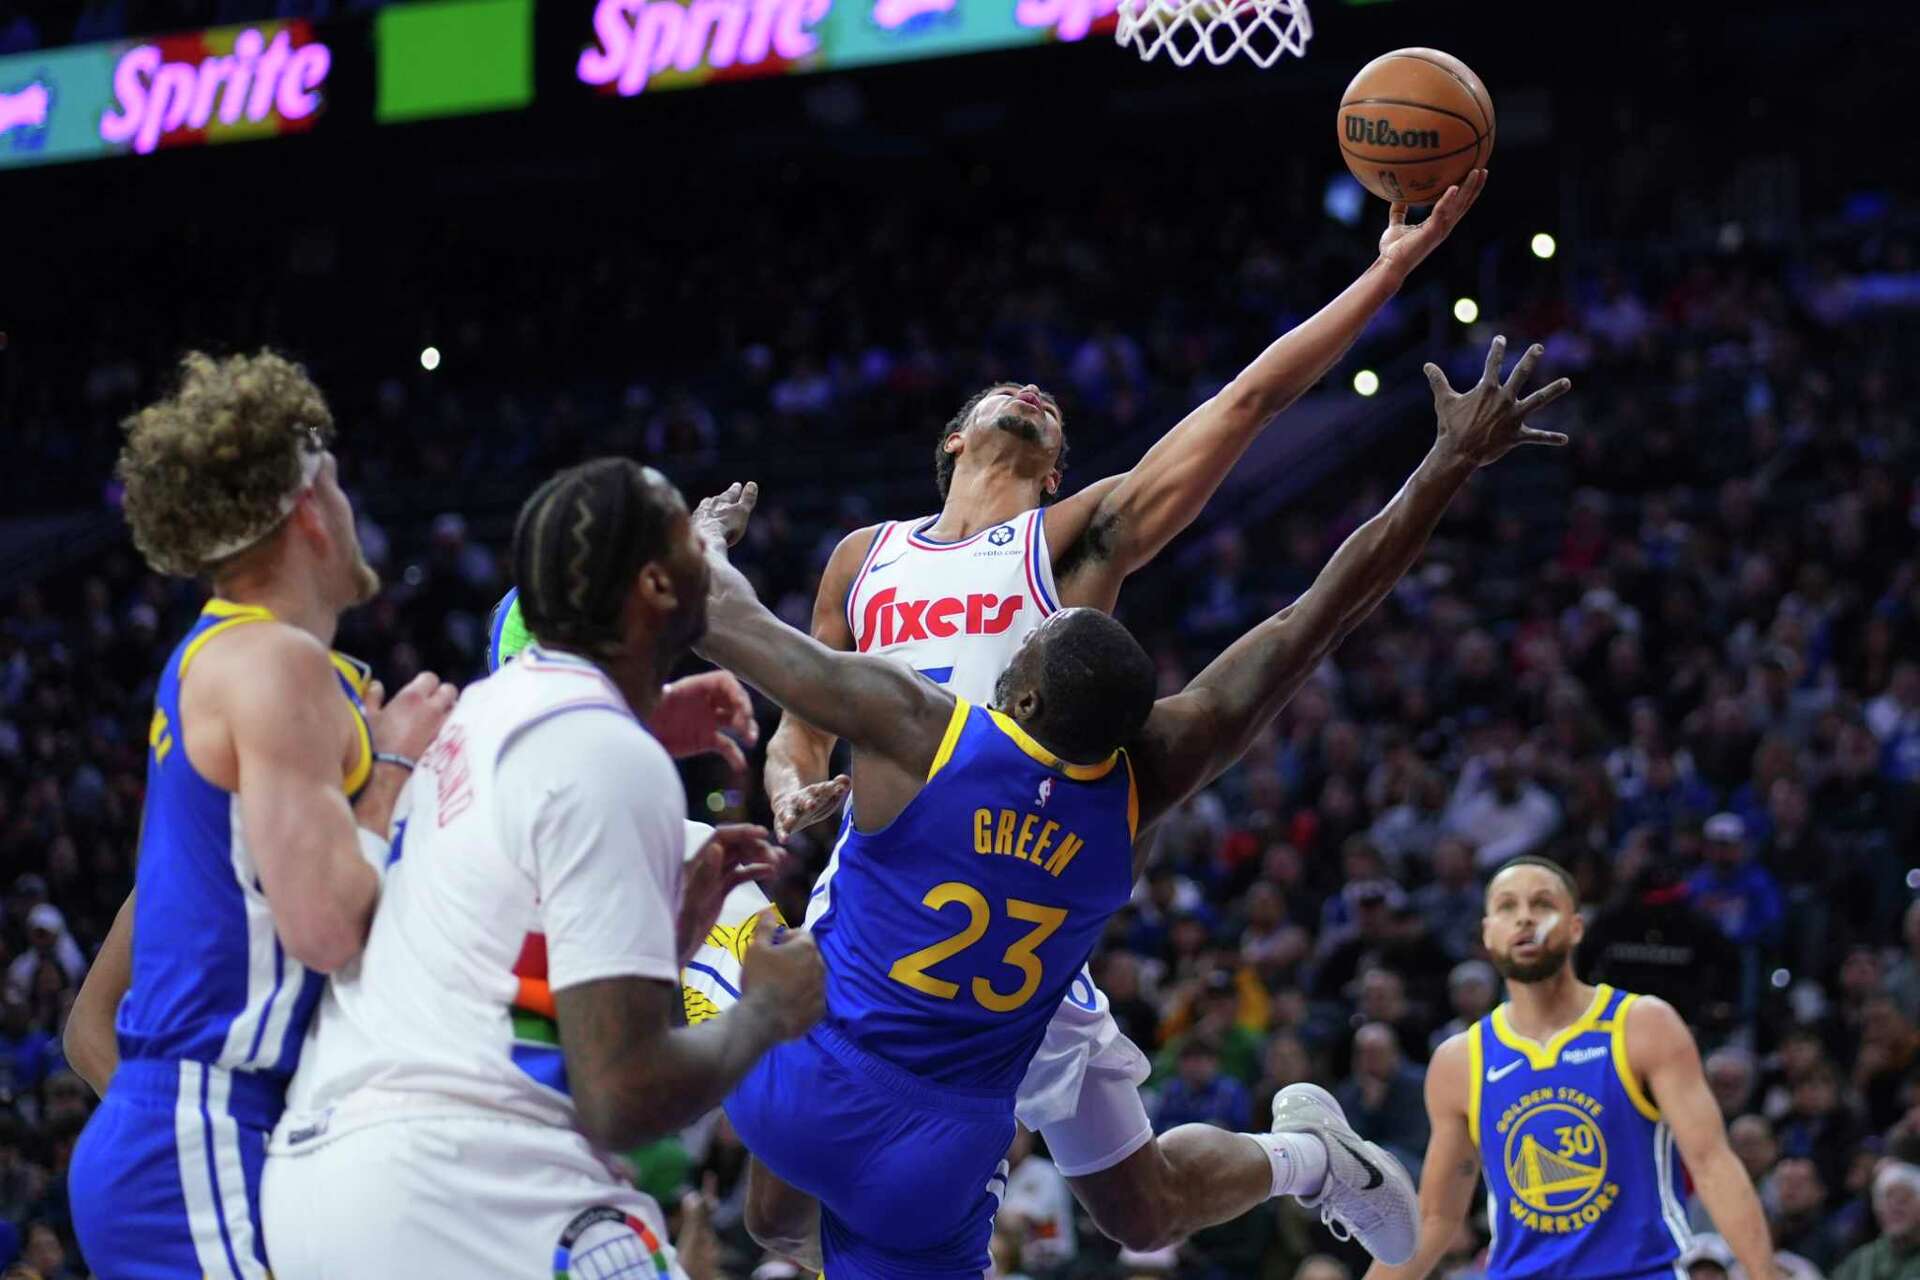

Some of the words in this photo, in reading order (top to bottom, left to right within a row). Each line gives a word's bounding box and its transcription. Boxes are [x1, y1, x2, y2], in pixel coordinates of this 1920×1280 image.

[576, 0, 836, 97] Sprite
[100, 29, 331, 155] Sprite
[1345, 115, 1440, 149] Wilson
[858, 586, 1024, 653] Sixers
[973, 807, 1086, 878] GREEN
[887, 881, 1069, 1014] 23
[1562, 1046, 1608, 1065] Rakuten
[1496, 1087, 1554, 1133] GOLDEN
[1557, 1087, 1605, 1117] STATE
[1553, 1124, 1595, 1159] 30
[1510, 1181, 1620, 1233] WARRIORS
